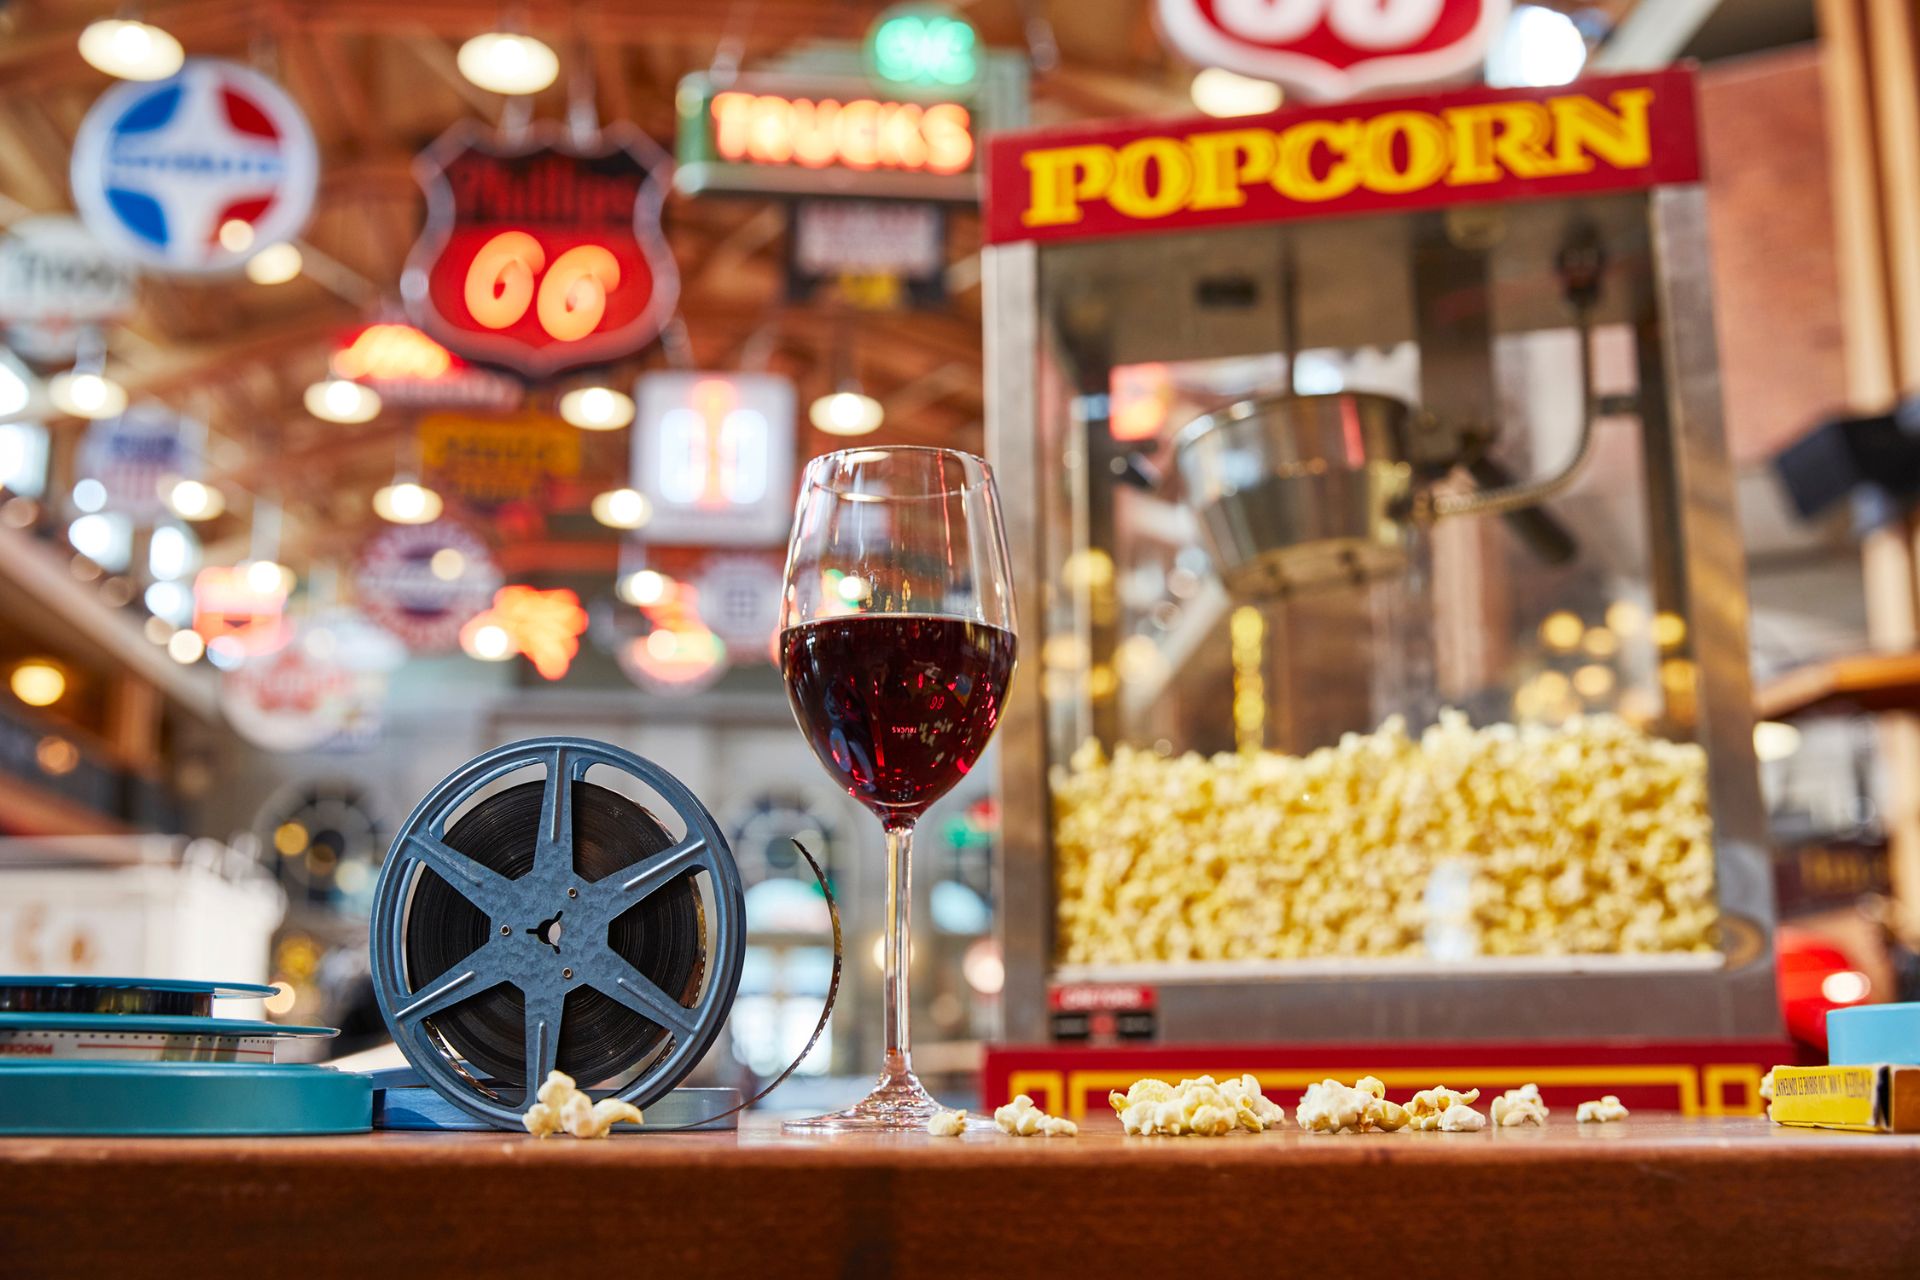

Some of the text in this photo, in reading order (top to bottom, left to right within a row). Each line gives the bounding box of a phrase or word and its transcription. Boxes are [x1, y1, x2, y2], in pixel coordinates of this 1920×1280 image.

[710, 91, 974, 175] TRUCKS
[1022, 87, 1655, 228] POPCORN
[464, 231, 621, 342] 66
